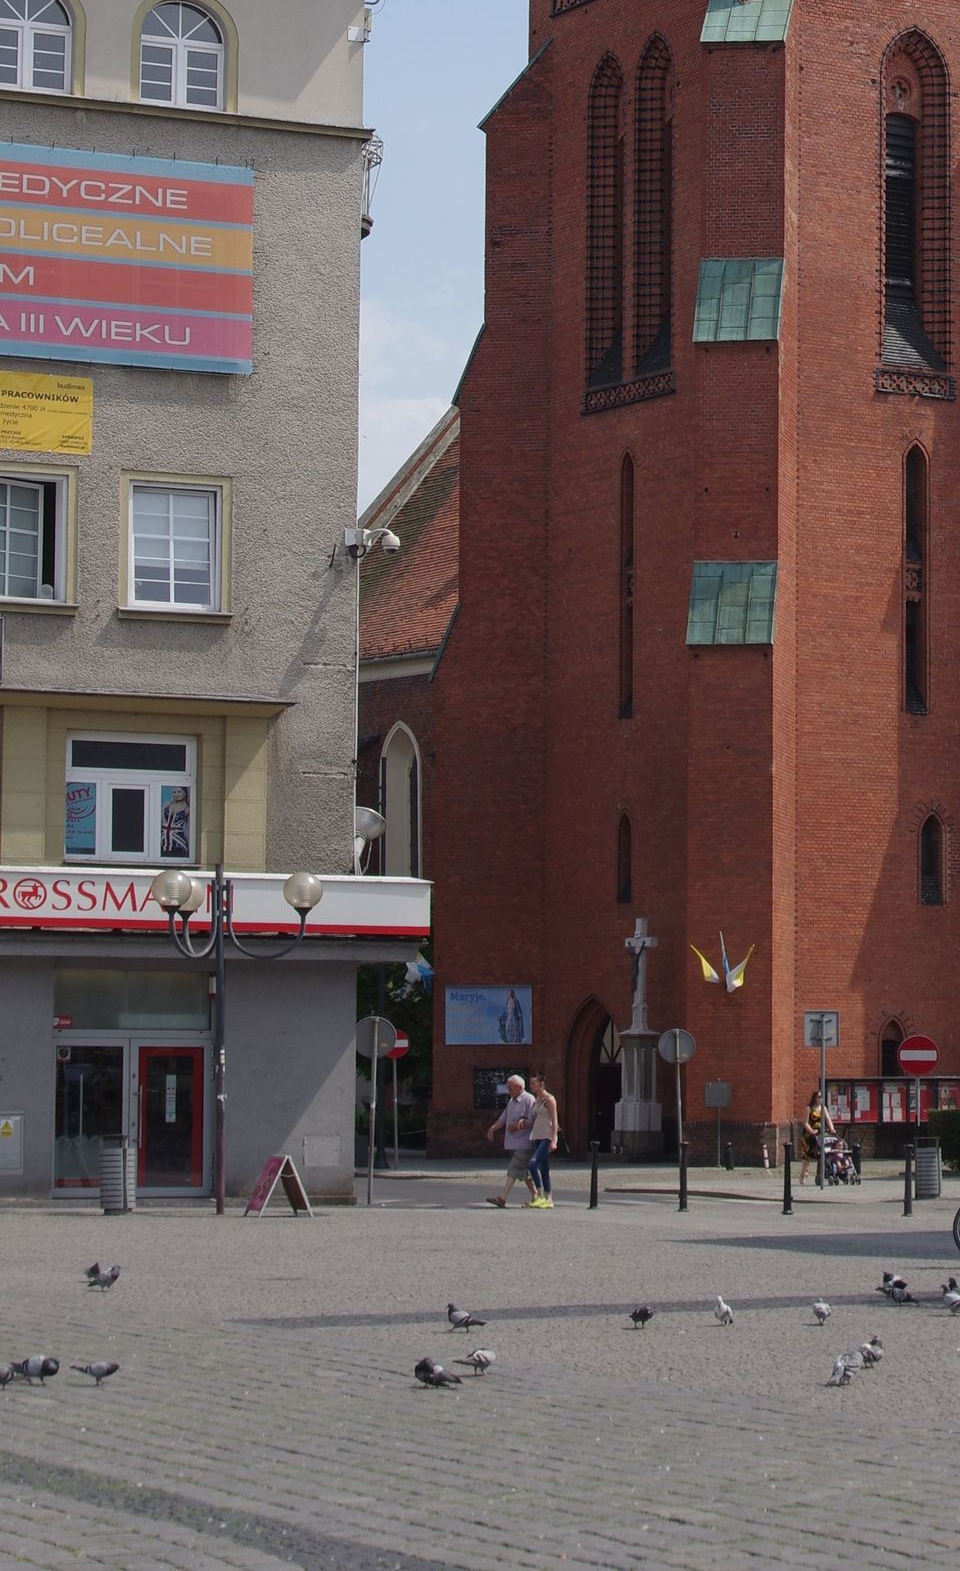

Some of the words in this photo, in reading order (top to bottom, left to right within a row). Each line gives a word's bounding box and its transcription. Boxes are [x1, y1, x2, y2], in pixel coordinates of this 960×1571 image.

[0, 172, 188, 209] EDYCZNE
[20, 312, 44, 334] III
[54, 315, 191, 346] WIEKU
[1, 390, 79, 403] PRACOWNIKÓW
[22, 404, 38, 412] 4700
